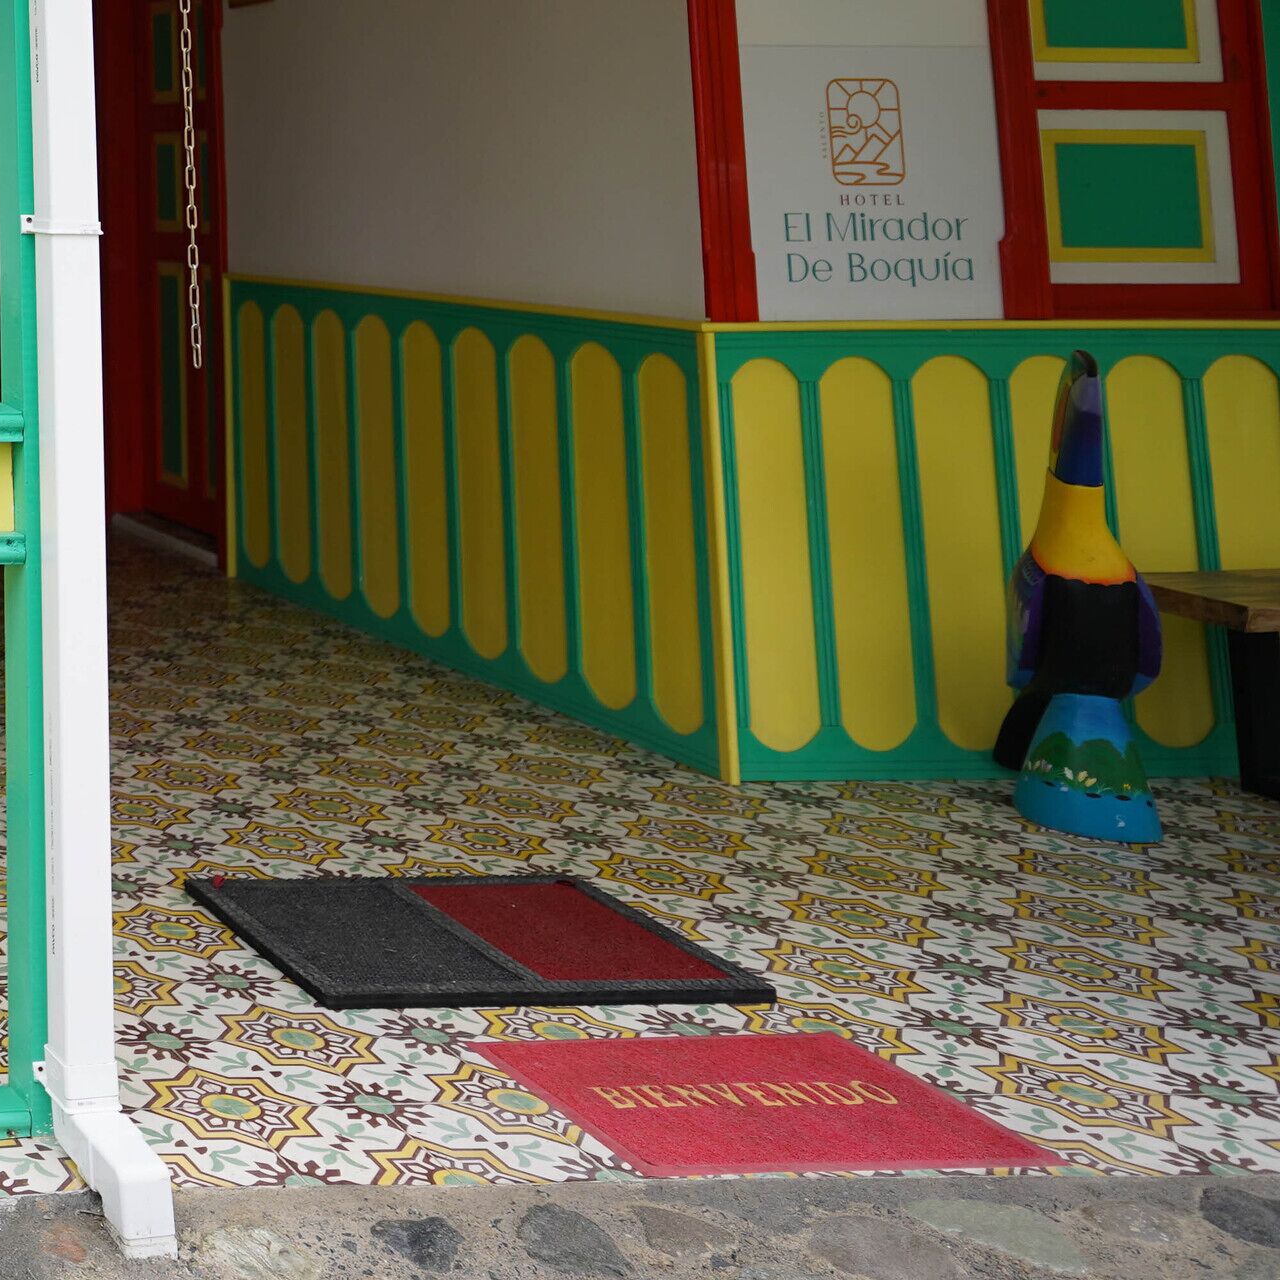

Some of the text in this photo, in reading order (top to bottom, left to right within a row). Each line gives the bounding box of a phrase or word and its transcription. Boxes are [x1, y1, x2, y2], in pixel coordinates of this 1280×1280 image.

[840, 194, 905, 206] HOTEL
[784, 211, 968, 242] El Mirador
[787, 251, 974, 288] De Boquía
[590, 1079, 899, 1109] BIENVENIDO
